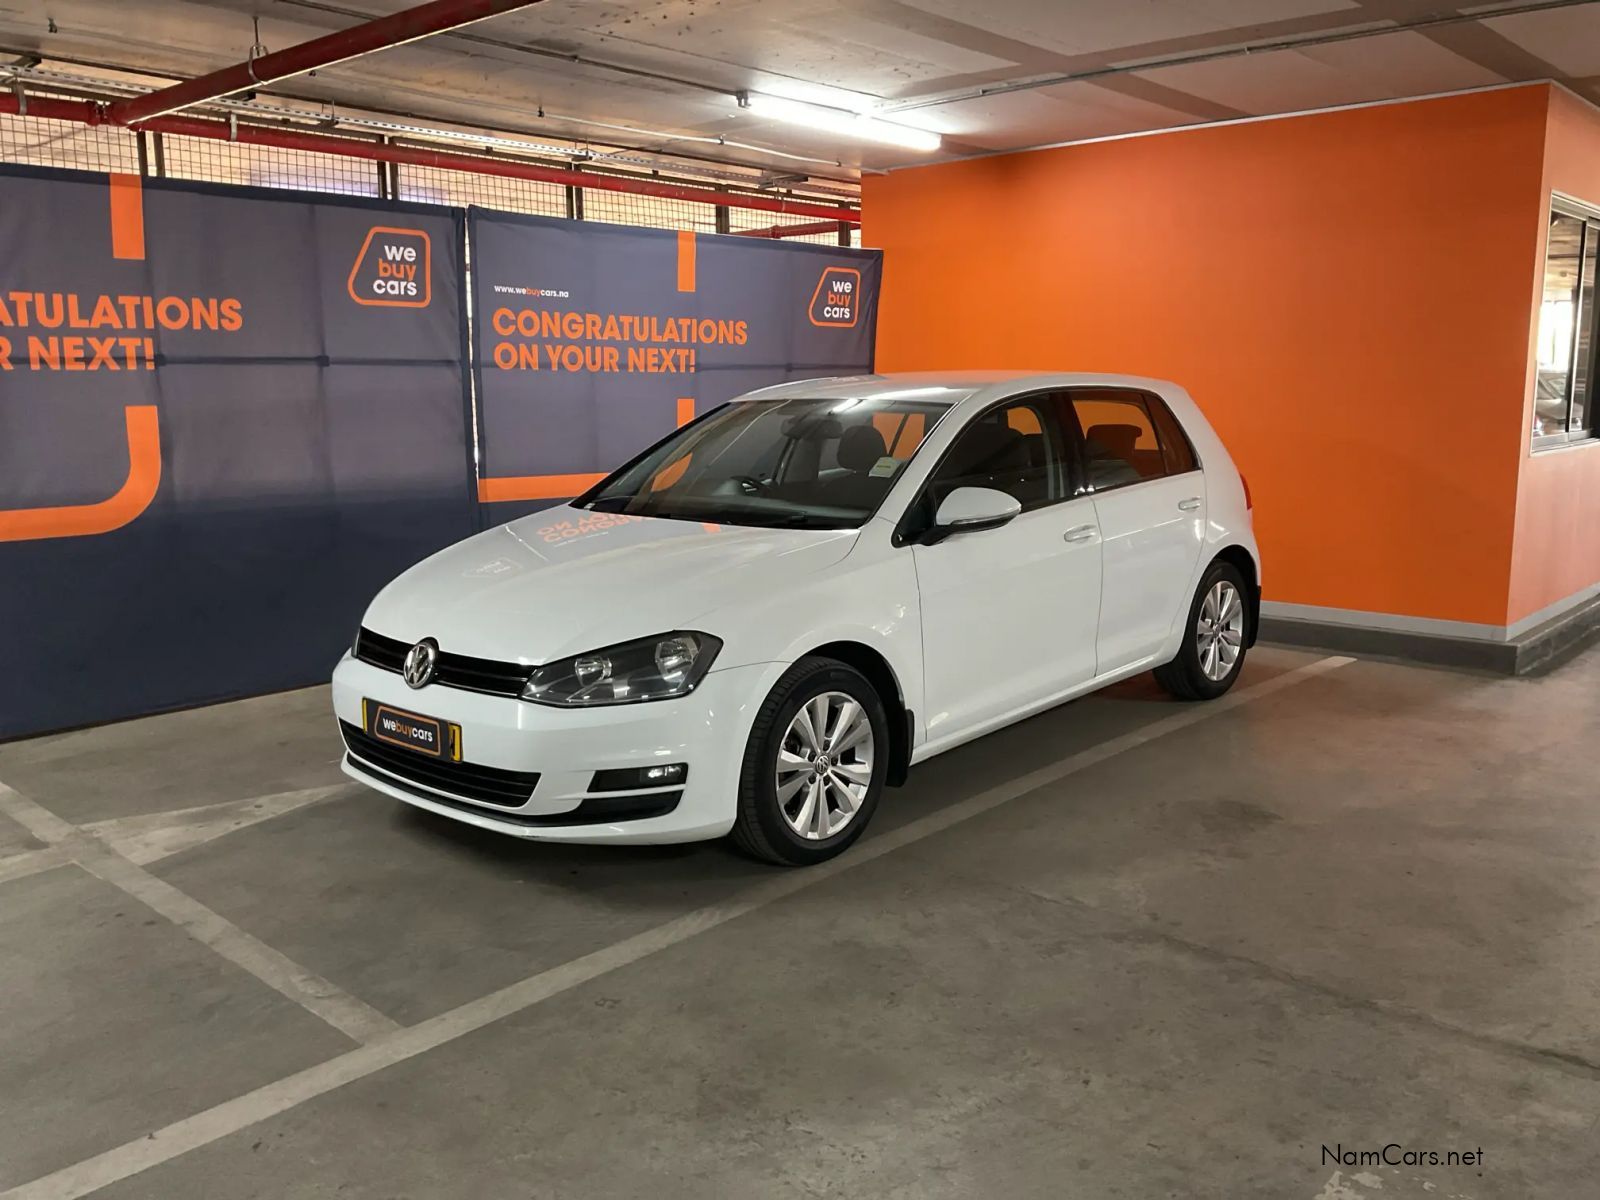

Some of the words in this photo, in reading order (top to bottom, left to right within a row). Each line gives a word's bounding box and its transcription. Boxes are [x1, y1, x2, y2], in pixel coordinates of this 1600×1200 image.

[384, 245, 416, 262] we
[378, 257, 416, 281] buy
[373, 279, 417, 296] cars
[494, 285, 569, 298] www.webuycars.na
[832, 280, 852, 293] we
[827, 290, 851, 307] buy
[823, 306, 850, 319] cars
[492, 307, 748, 345] CONGRATULATIONS
[28, 336, 155, 371] NEXT!
[494, 342, 539, 370] ON
[545, 344, 619, 373] YOUR
[627, 347, 695, 373] NEXT!
[383, 718, 433, 742] webuycars
